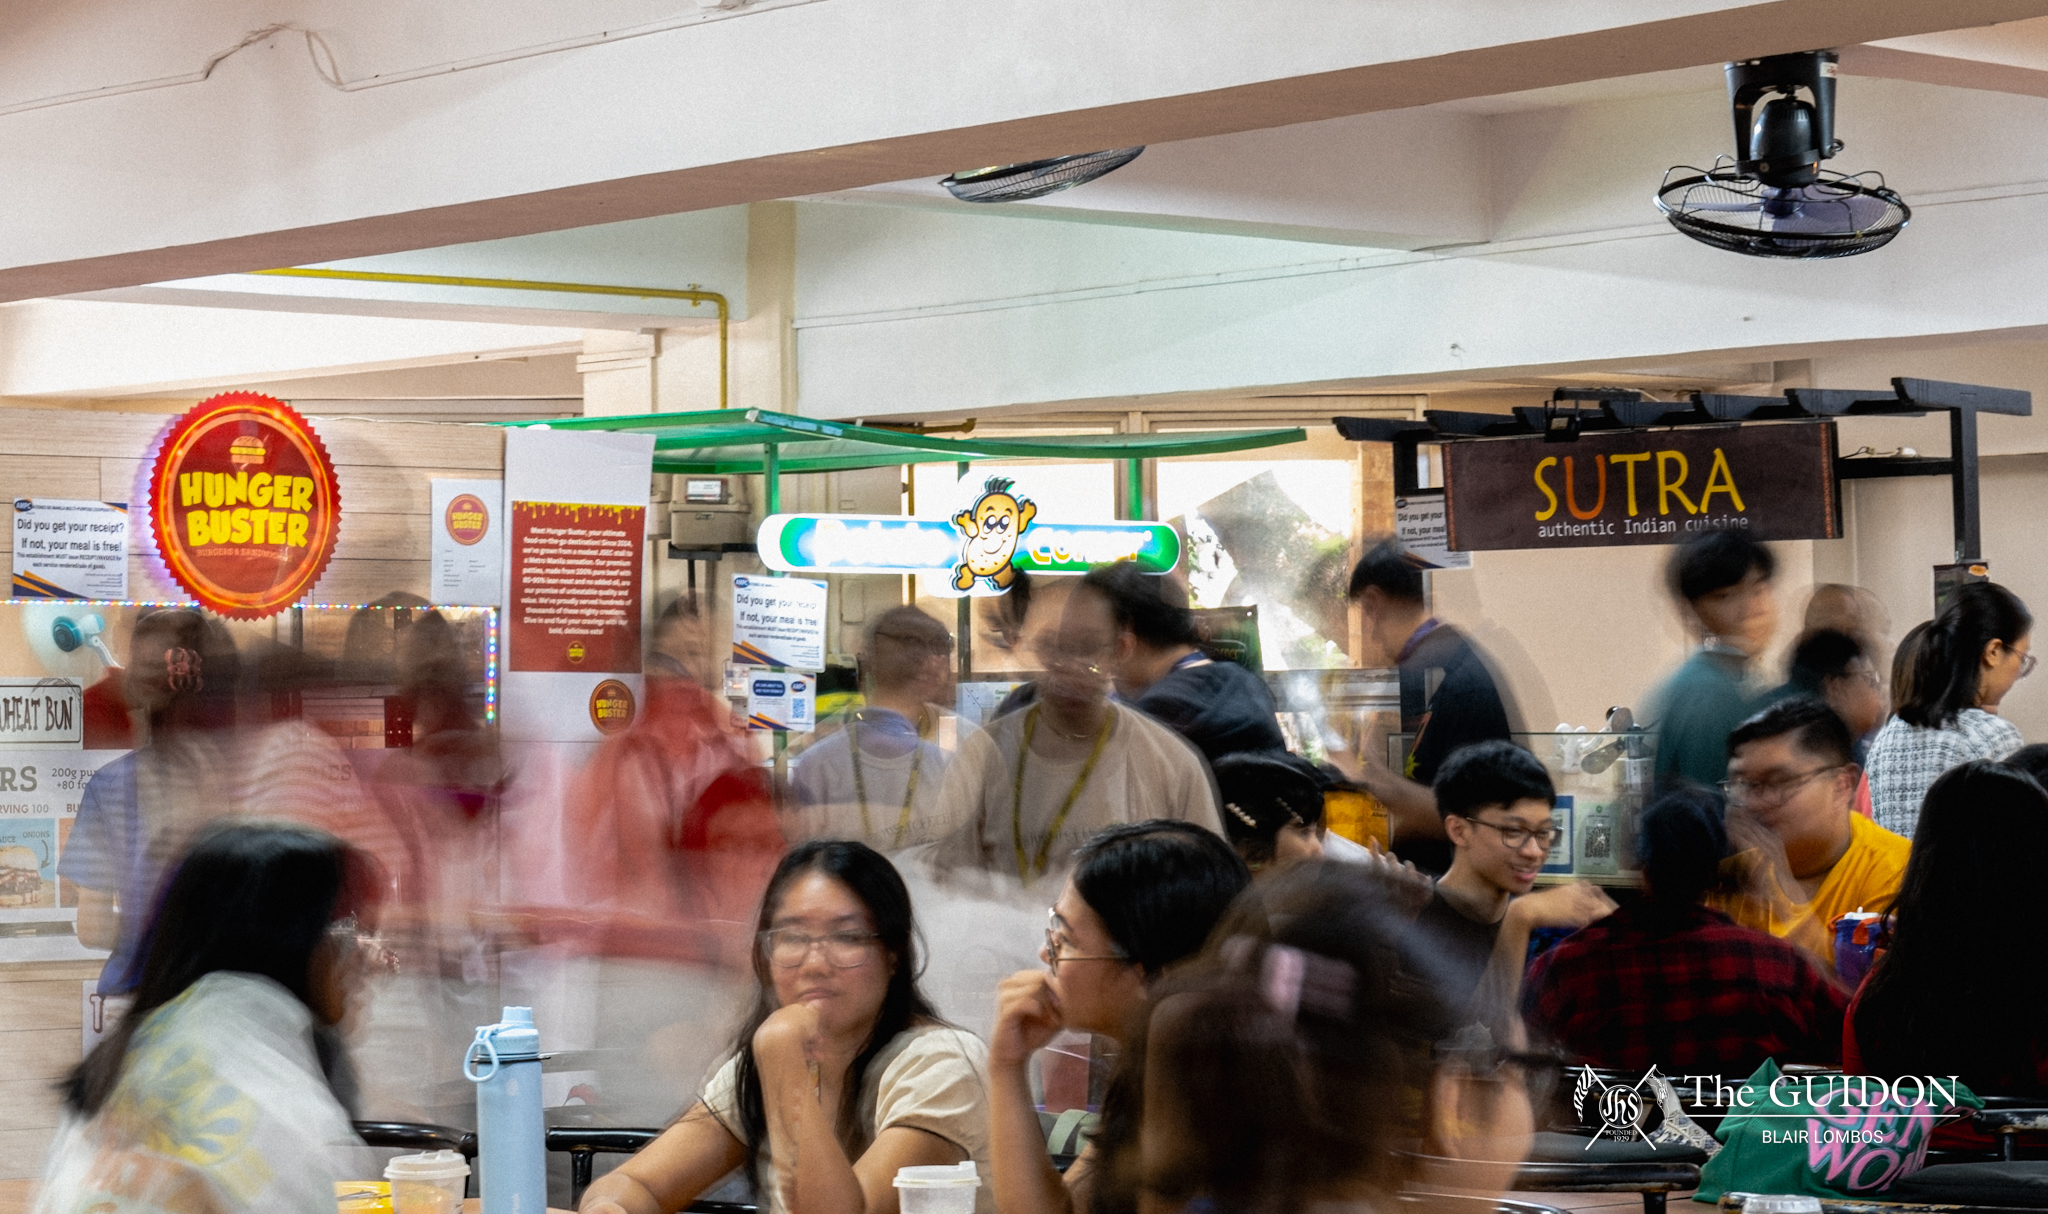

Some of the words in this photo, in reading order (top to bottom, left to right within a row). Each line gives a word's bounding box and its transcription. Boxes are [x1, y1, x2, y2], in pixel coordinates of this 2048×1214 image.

[1534, 447, 1746, 521] SUTRA
[180, 471, 315, 512] HUNGER
[1398, 513, 1408, 522] Did
[1409, 514, 1418, 523] you
[1420, 512, 1429, 522] get
[1430, 512, 1443, 522] your
[17, 518, 32, 530] Did
[34, 522, 50, 533] you
[52, 521, 66, 533] get
[68, 523, 88, 534] your
[90, 522, 125, 535] receipt?
[186, 508, 309, 548] BUSTER
[1402, 527, 1406, 535] If
[1407, 526, 1417, 535] not,
[1419, 527, 1431, 535] your
[1538, 519, 1615, 538] authentic
[1624, 517, 1677, 534] Indian
[1685, 514, 1749, 532] cuisine
[22, 538, 28, 549] If
[29, 540, 46, 551] not,
[48, 542, 68, 552] your
[70, 540, 91, 551] meal
[93, 541, 101, 551] is
[102, 541, 122, 552] free!
[736, 594, 749, 604] Did
[750, 597, 763, 607] you
[765, 597, 776, 608] get
[740, 611, 745, 621] If
[746, 613, 760, 623] not,
[761, 615, 777, 625] your
[596, 698, 628, 709] HUNGER
[45, 696, 74, 732] BUN
[597, 708, 627, 718] BUSTER
[51, 768, 78, 779] 200g
[80, 769, 97, 779] pur
[57, 780, 75, 790] +80
[77, 780, 86, 790] fo
[32, 804, 49, 813] 100
[66, 804, 80, 813] BU
[1813, 1087, 1936, 1149] GEN
